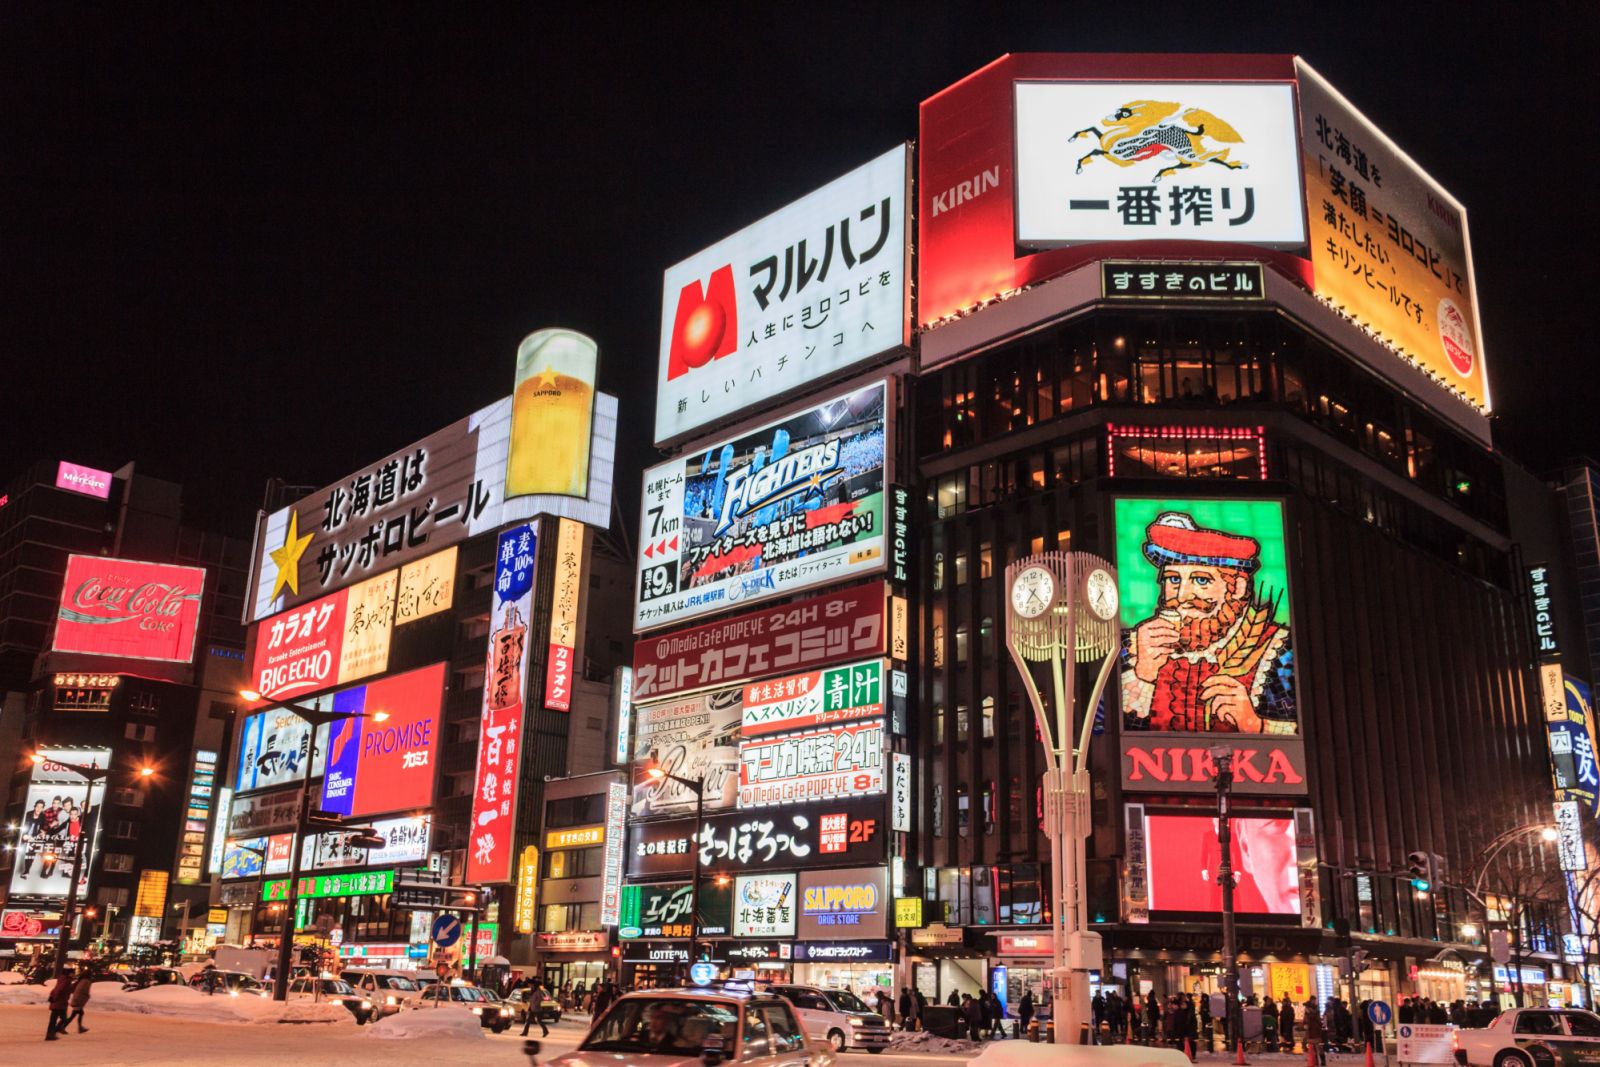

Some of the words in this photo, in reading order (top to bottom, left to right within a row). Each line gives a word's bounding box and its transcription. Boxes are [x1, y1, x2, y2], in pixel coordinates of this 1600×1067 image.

[1316, 113, 1382, 188] 北海道を
[932, 165, 999, 217] KIRIN
[1069, 185, 1256, 226] 一番搾り
[750, 196, 891, 312] マルハン
[1112, 272, 1253, 291] すすきのビル
[747, 270, 891, 348] 人生にヨロコビを
[677, 321, 875, 414] 新しいパチンコへ
[63, 472, 105, 489] Mercure
[322, 449, 425, 531] 北海道は
[647, 473, 683, 495] 札幌ドーム
[658, 489, 671, 501] まで
[713, 438, 842, 538] FIGHTERS
[316, 480, 490, 586] サッポロビール
[648, 505, 679, 538] 7km
[690, 515, 806, 564] ファイターズを見ずに
[895, 489, 908, 580] すすきのビル
[498, 539, 516, 592] 革命
[778, 568, 798, 582] または
[801, 557, 843, 575] ファイターズ
[140, 616, 175, 632] Coke
[267, 603, 335, 649] カラオケ
[699, 630, 721, 648] Cafe
[723, 617, 764, 642] POPEYE
[769, 605, 817, 630] 24H
[825, 600, 858, 617] 8F
[1530, 566, 1556, 650] すすきのビル
[267, 652, 288, 664] Karaoke
[289, 638, 327, 657] Entertainment
[552, 647, 569, 698] カラオケ
[258, 664, 288, 699] BIG
[288, 649, 332, 682] ECHO
[749, 676, 809, 702] 新生活習慣
[825, 669, 879, 710] 青汁
[745, 699, 820, 722] ヘスペリジン
[815, 712, 840, 723] ドリーム
[842, 706, 880, 719] ファクトリー
[364, 719, 432, 758] PROMISE
[402, 751, 428, 769] プロミス
[742, 733, 836, 782] マンガ喫茶
[837, 728, 881, 772] 24H
[501, 718, 518, 816] 本格麦焼酎
[1126, 746, 1302, 784] NIKKA
[782, 781, 805, 799] Cafe
[807, 776, 849, 796] POPEYE
[854, 775, 880, 791] 8F
[636, 838, 688, 856] 北の味紀行
[691, 814, 812, 867] さっぽろっこ
[850, 819, 876, 843] 2F
[804, 884, 877, 911] SAPPORO
[817, 914, 835, 925] DRUG
[837, 913, 860, 925] STORE
